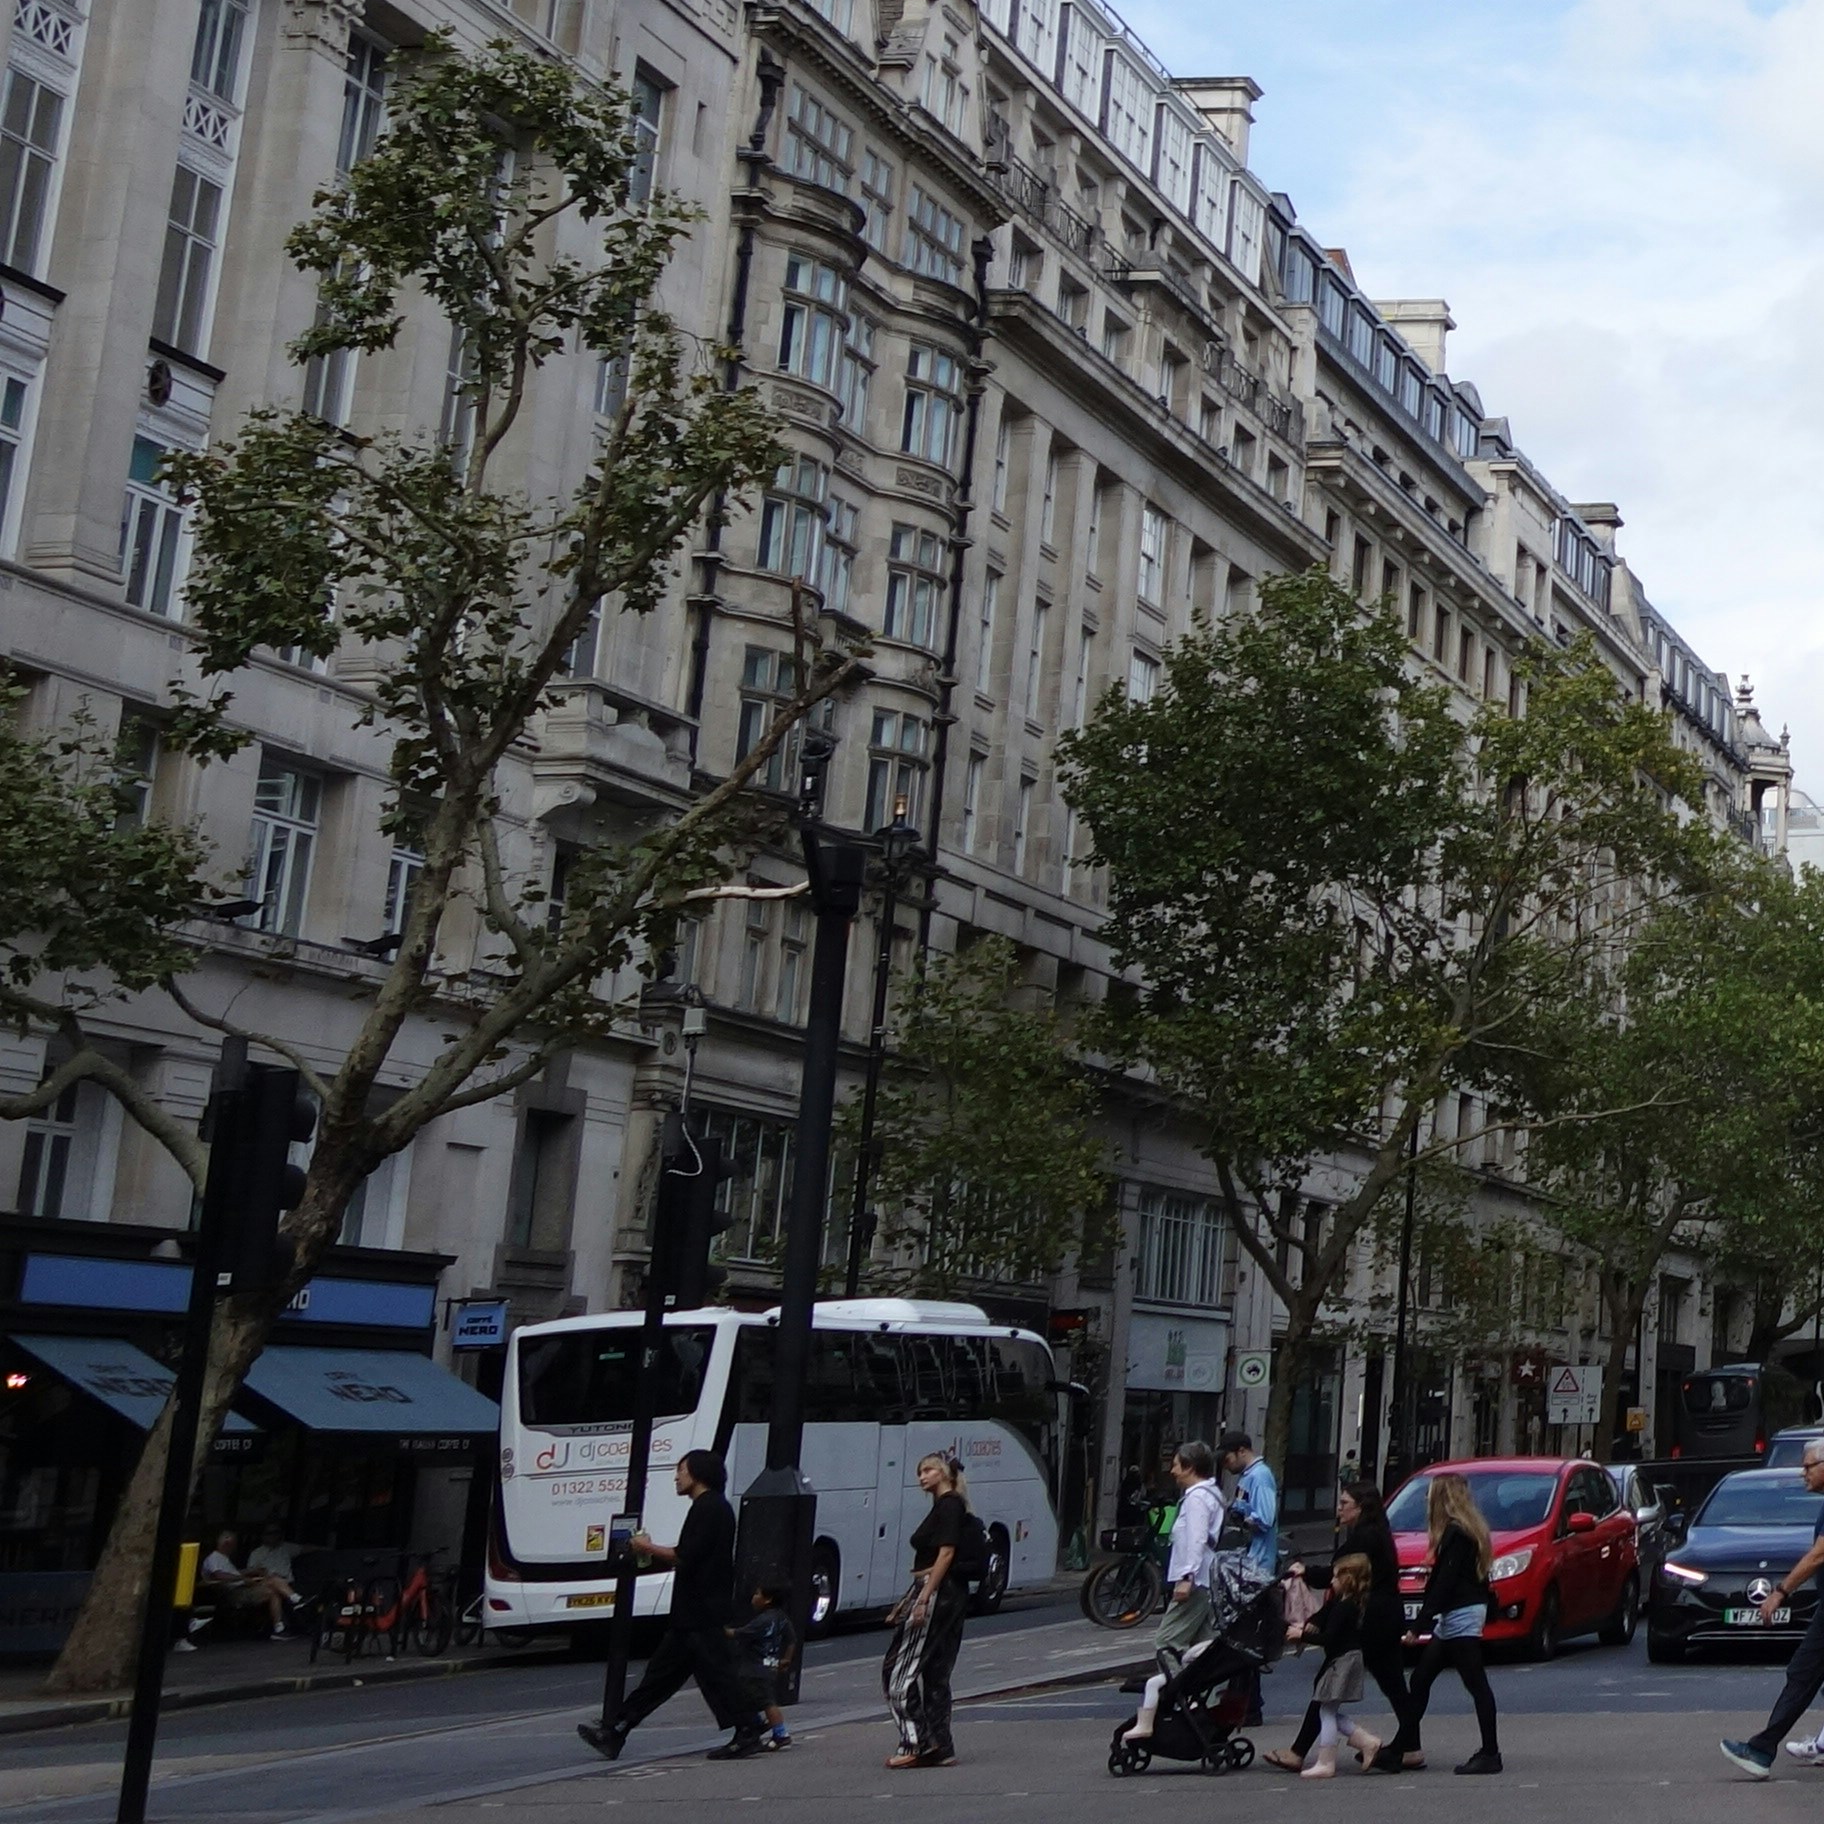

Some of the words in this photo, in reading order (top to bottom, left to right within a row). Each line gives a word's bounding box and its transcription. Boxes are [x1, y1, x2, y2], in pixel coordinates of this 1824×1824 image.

[458, 1325, 499, 1336] NERO
[579, 1438, 673, 1462] djcoaes
[551, 1480, 594, 1496] 01322
